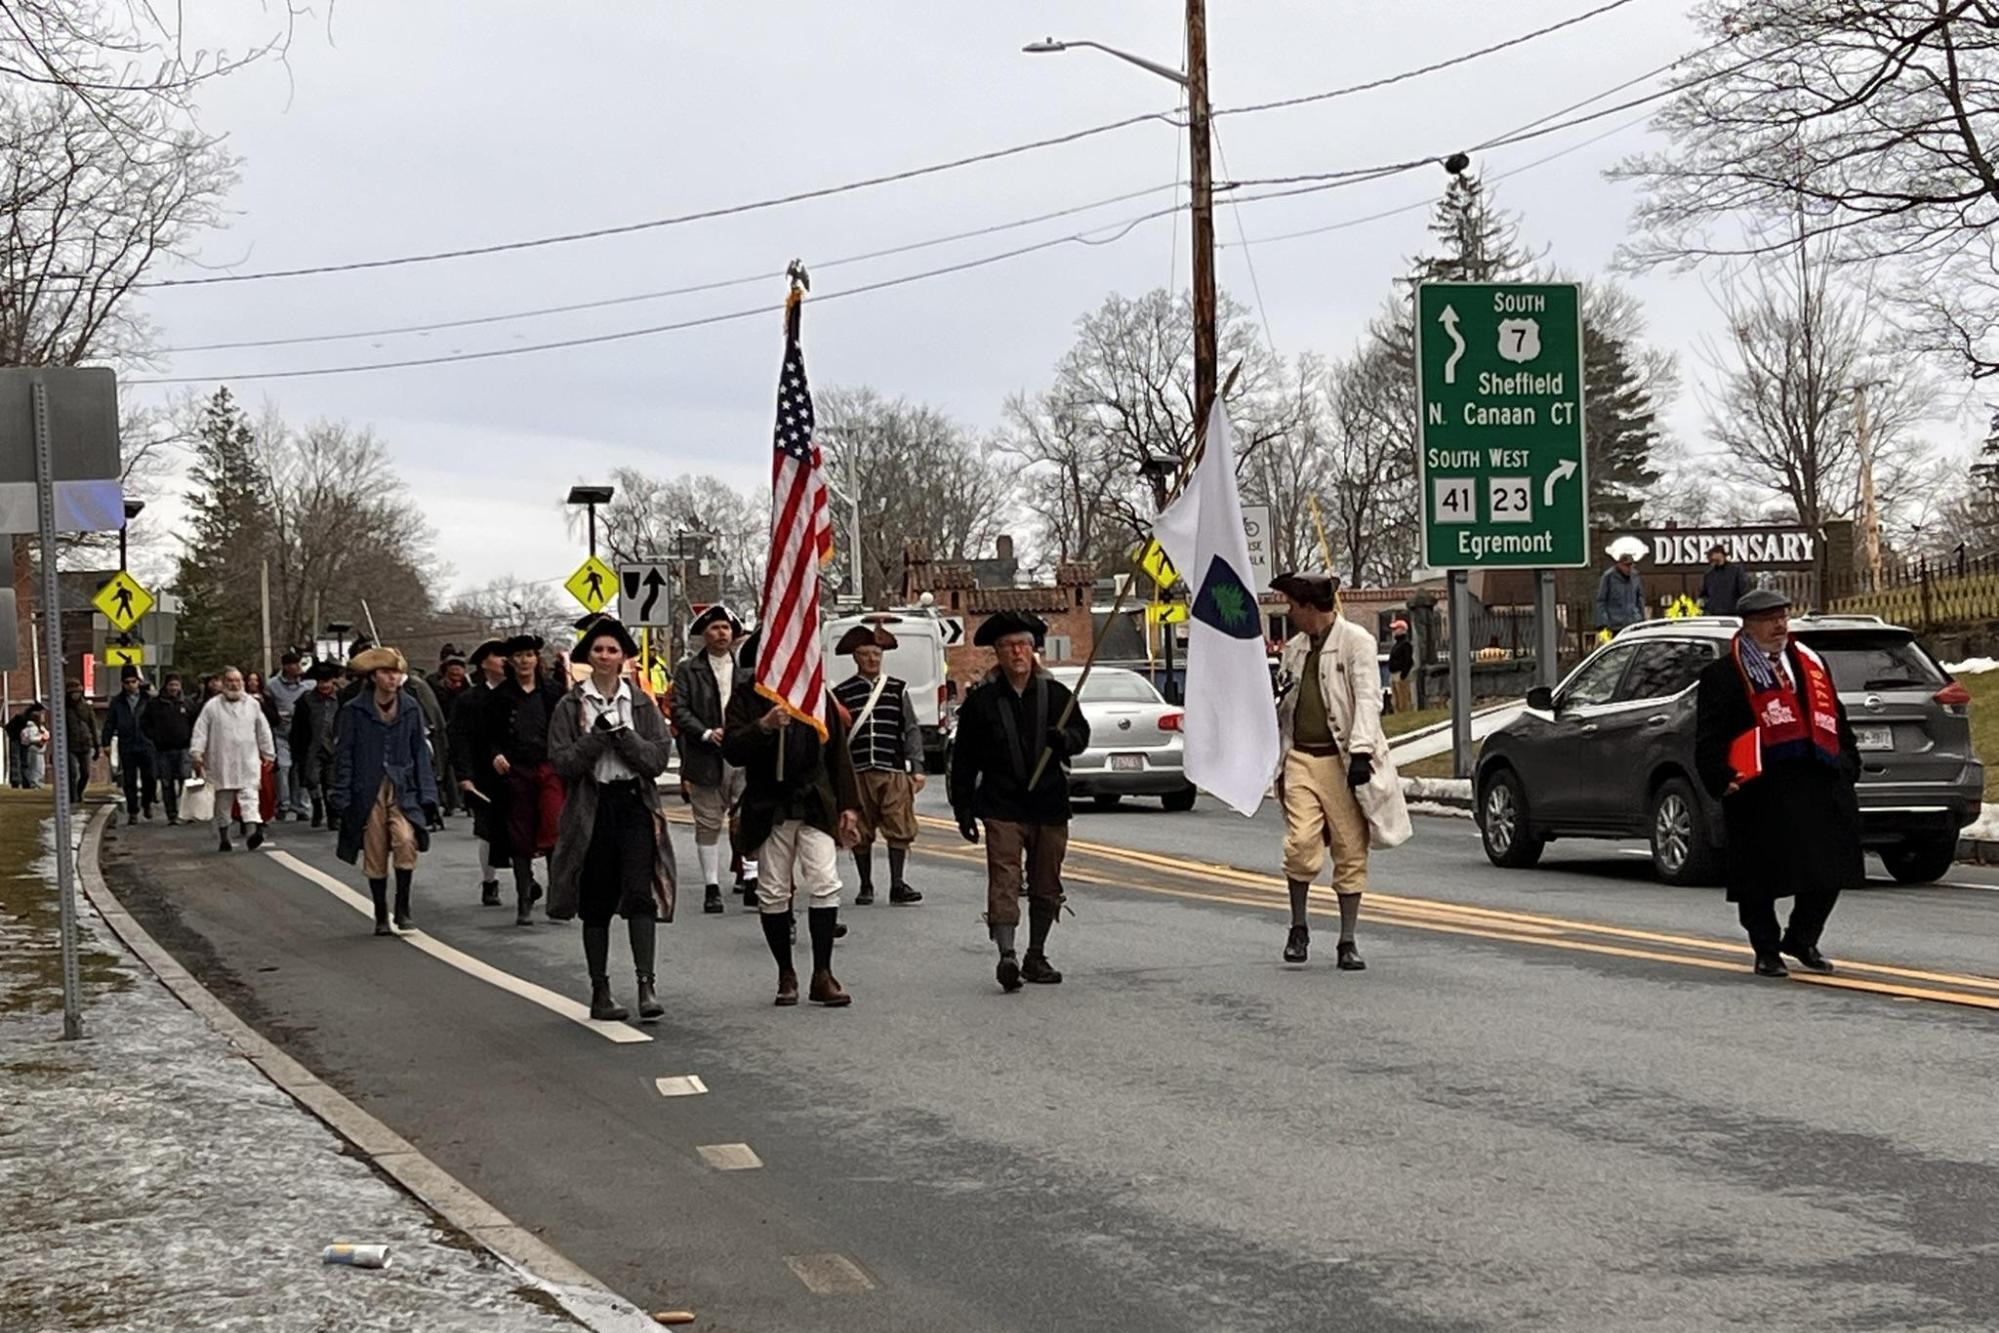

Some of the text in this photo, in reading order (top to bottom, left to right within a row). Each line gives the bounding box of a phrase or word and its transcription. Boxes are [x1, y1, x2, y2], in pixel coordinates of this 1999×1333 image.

[1494, 293, 1545, 313] SOUTH
[1511, 329, 1527, 353] 7
[1478, 372, 1563, 395] Sheffield
[1428, 402, 1575, 425] N. Canaan CT
[1428, 448, 1529, 468] SOUTH WEST
[1442, 488, 1469, 513] 41
[1493, 488, 1528, 512] 23
[1458, 530, 1553, 560] Egremont
[1653, 533, 1815, 565] DISPENSARY
